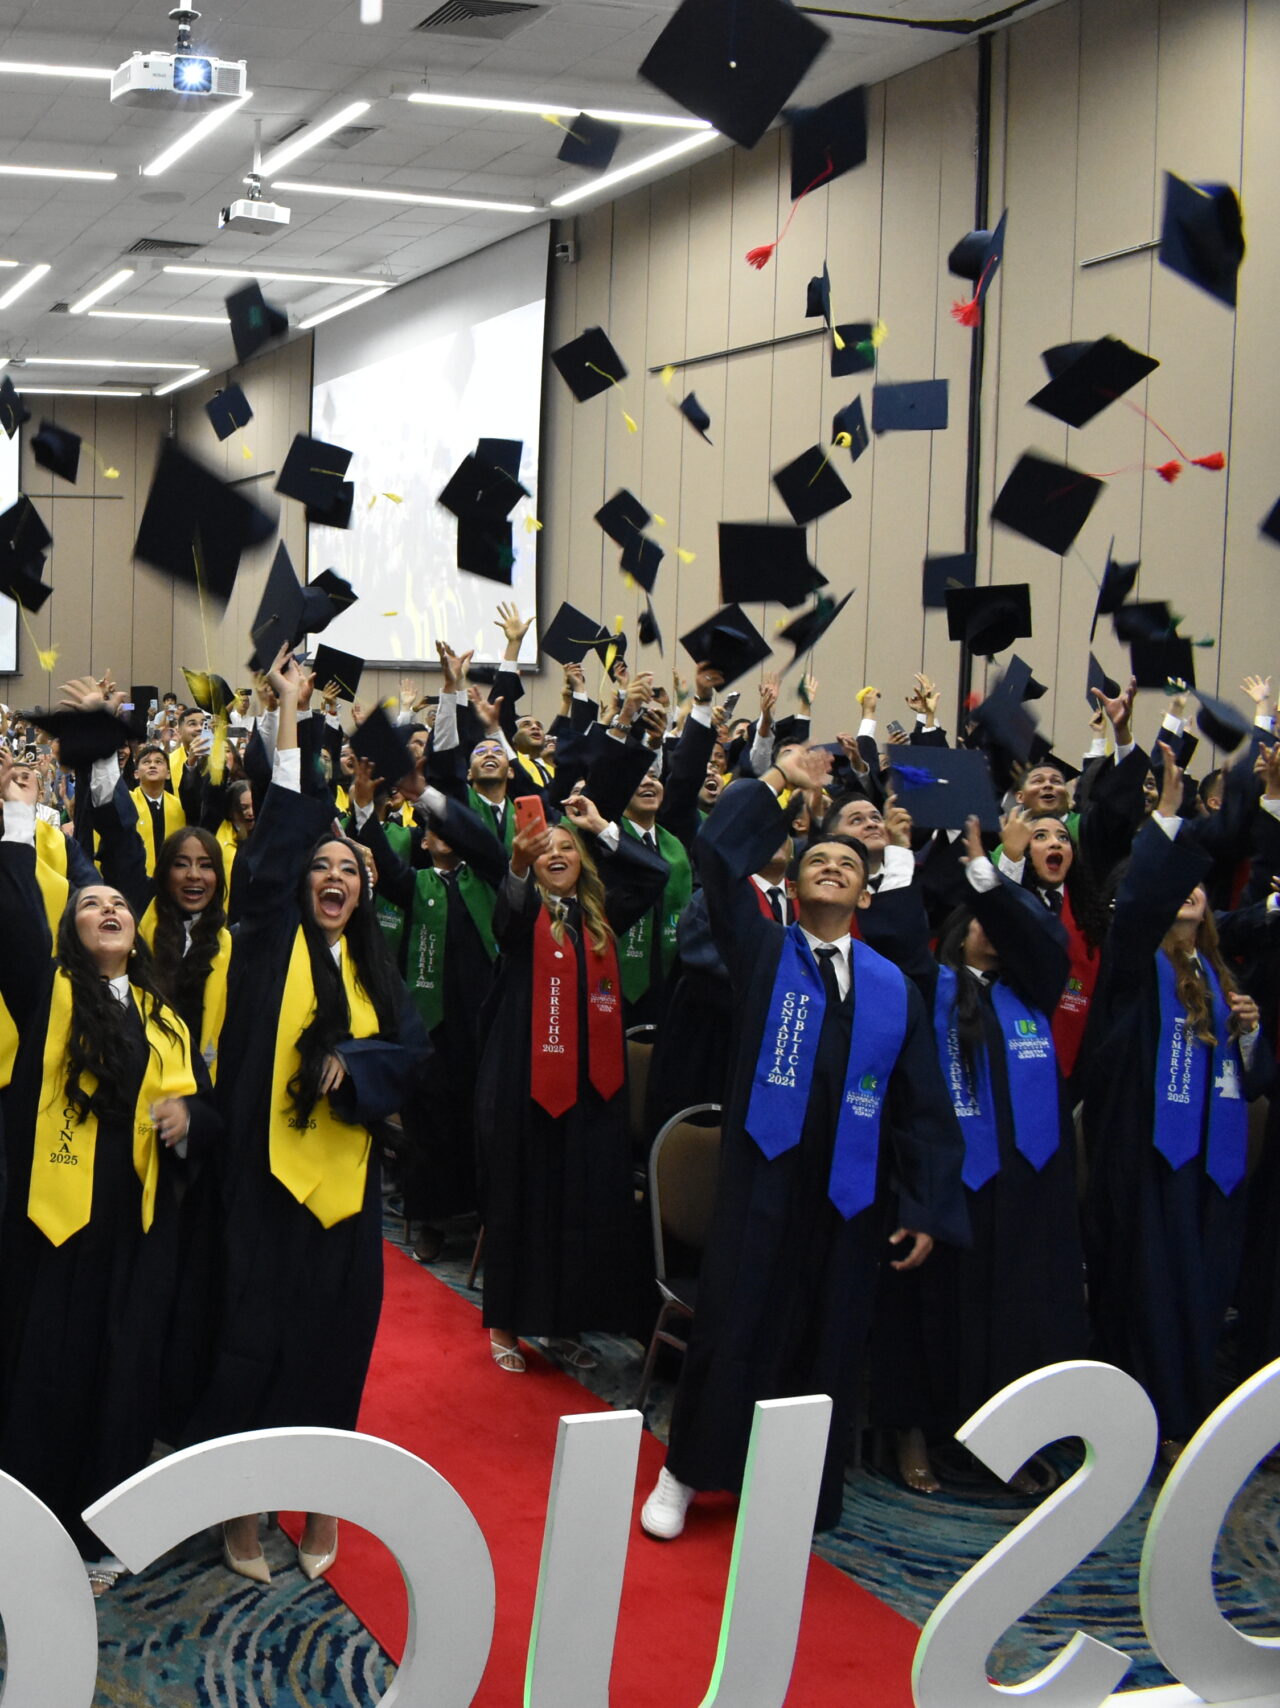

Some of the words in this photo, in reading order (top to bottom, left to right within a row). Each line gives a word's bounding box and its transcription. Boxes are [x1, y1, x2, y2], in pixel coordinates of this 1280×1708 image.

[428, 934, 437, 973] CIVIL
[548, 977, 561, 1044] DERECHO
[542, 1044, 565, 1054] 2025
[770, 992, 797, 1075] CONTADURÍA
[785, 994, 810, 1078] PÚBLICA
[1167, 1023, 1183, 1092] COMERCIO
[767, 1073, 796, 1088] 2024
[1167, 1092, 1191, 1104] 2025
[49, 1153, 79, 1166] 2025
